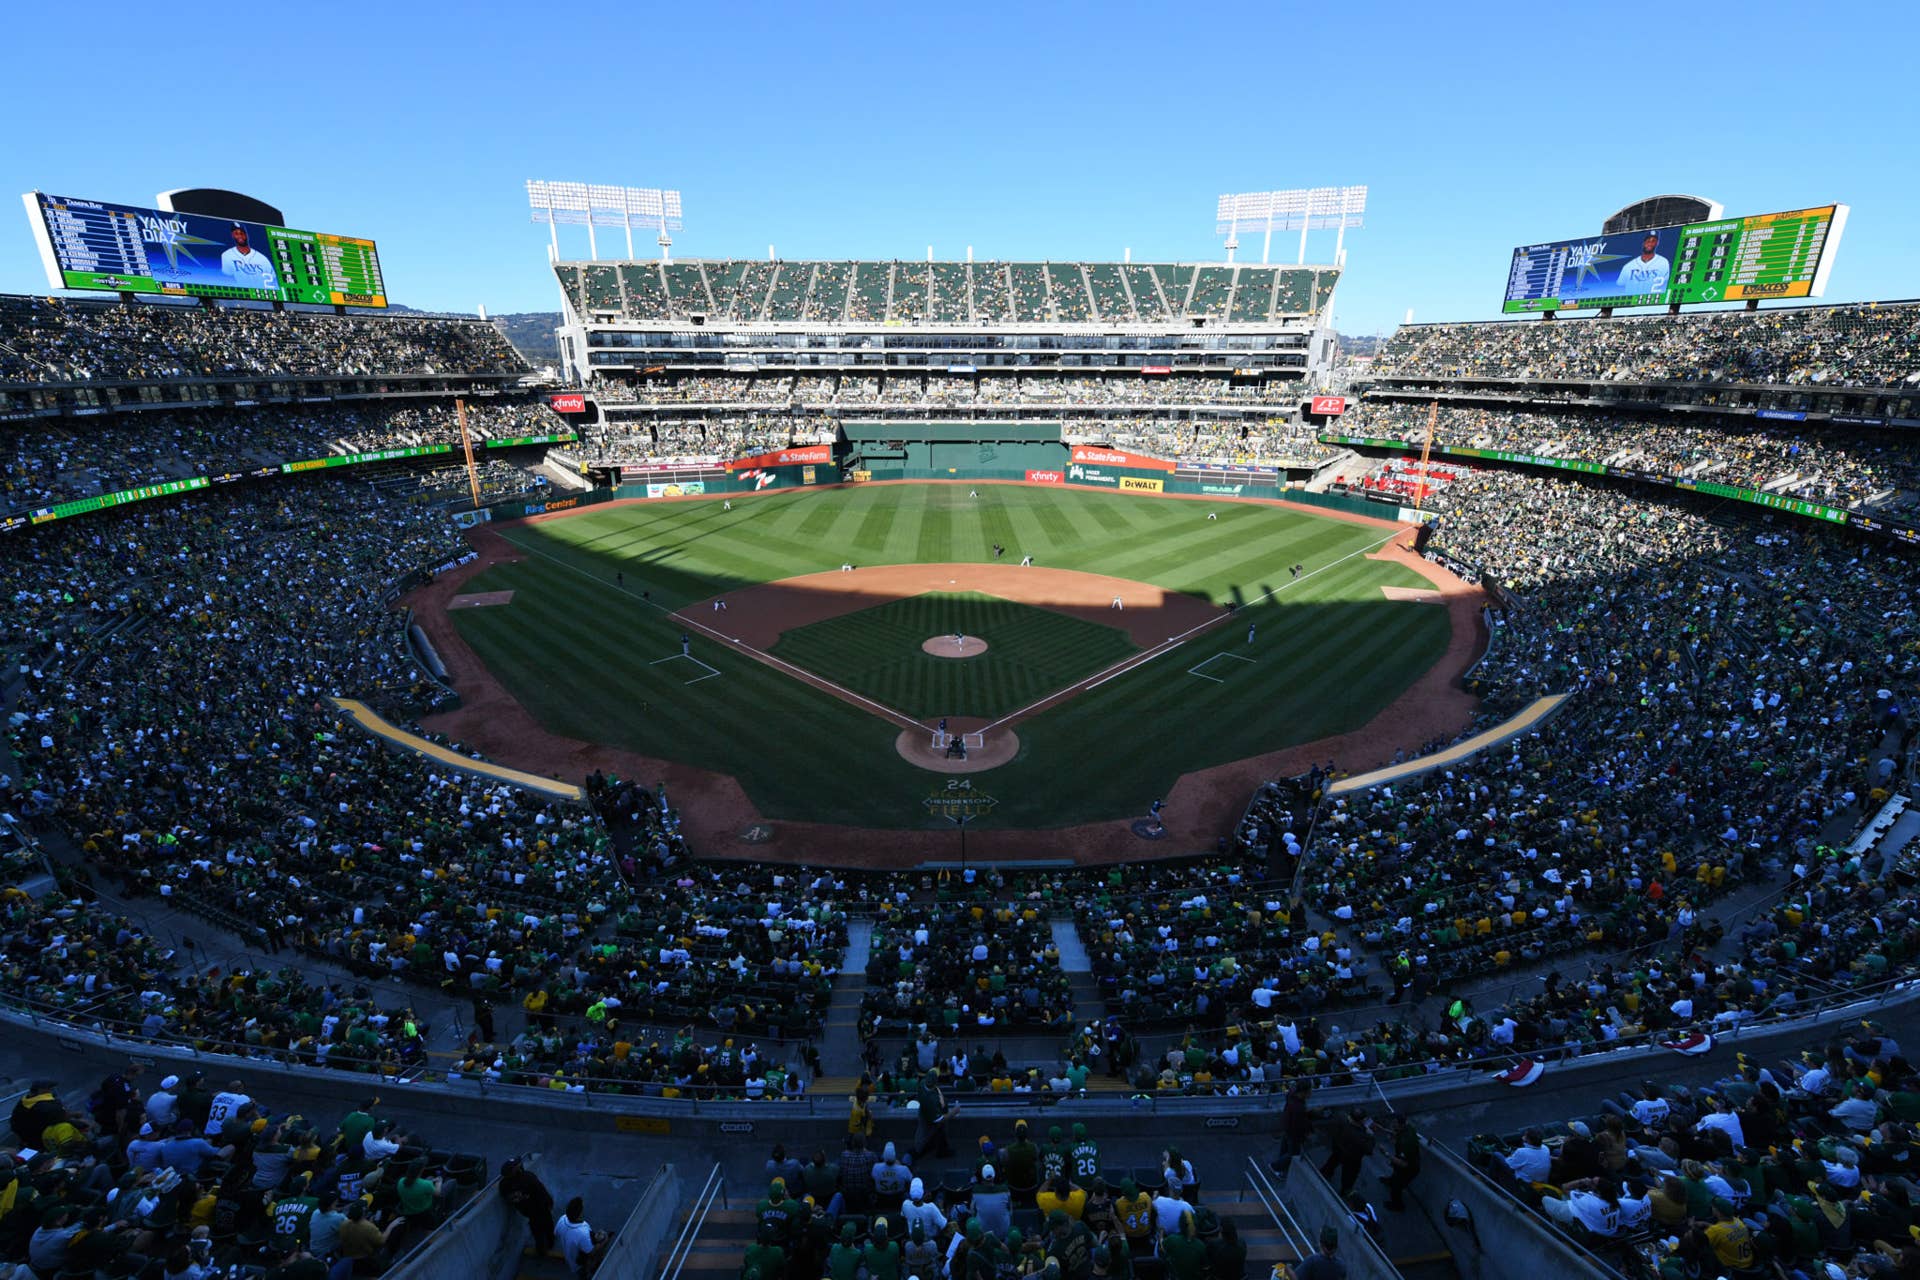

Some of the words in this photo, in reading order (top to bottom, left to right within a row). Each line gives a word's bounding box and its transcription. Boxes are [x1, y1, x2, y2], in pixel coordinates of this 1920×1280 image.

[139, 215, 188, 234] YANDY
[143, 229, 178, 245] DIAZ
[1571, 243, 1607, 255] YANDY
[1567, 256, 1592, 268] DIAZ
[262, 273, 276, 288] 2
[1651, 276, 1664, 293] 2
[553, 398, 583, 410] xfinity
[1031, 472, 1058, 482] xfinity
[947, 779, 971, 790] 24
[930, 805, 992, 816] FIELD
[209, 1105, 228, 1122] 33
[1071, 1145, 1097, 1159] CHAPMAN
[1077, 1158, 1097, 1176] 26
[880, 1180, 899, 1191] 54
[275, 1202, 309, 1216] CHAPMAN
[276, 1215, 299, 1235] 26
[1125, 1211, 1150, 1231] 44
